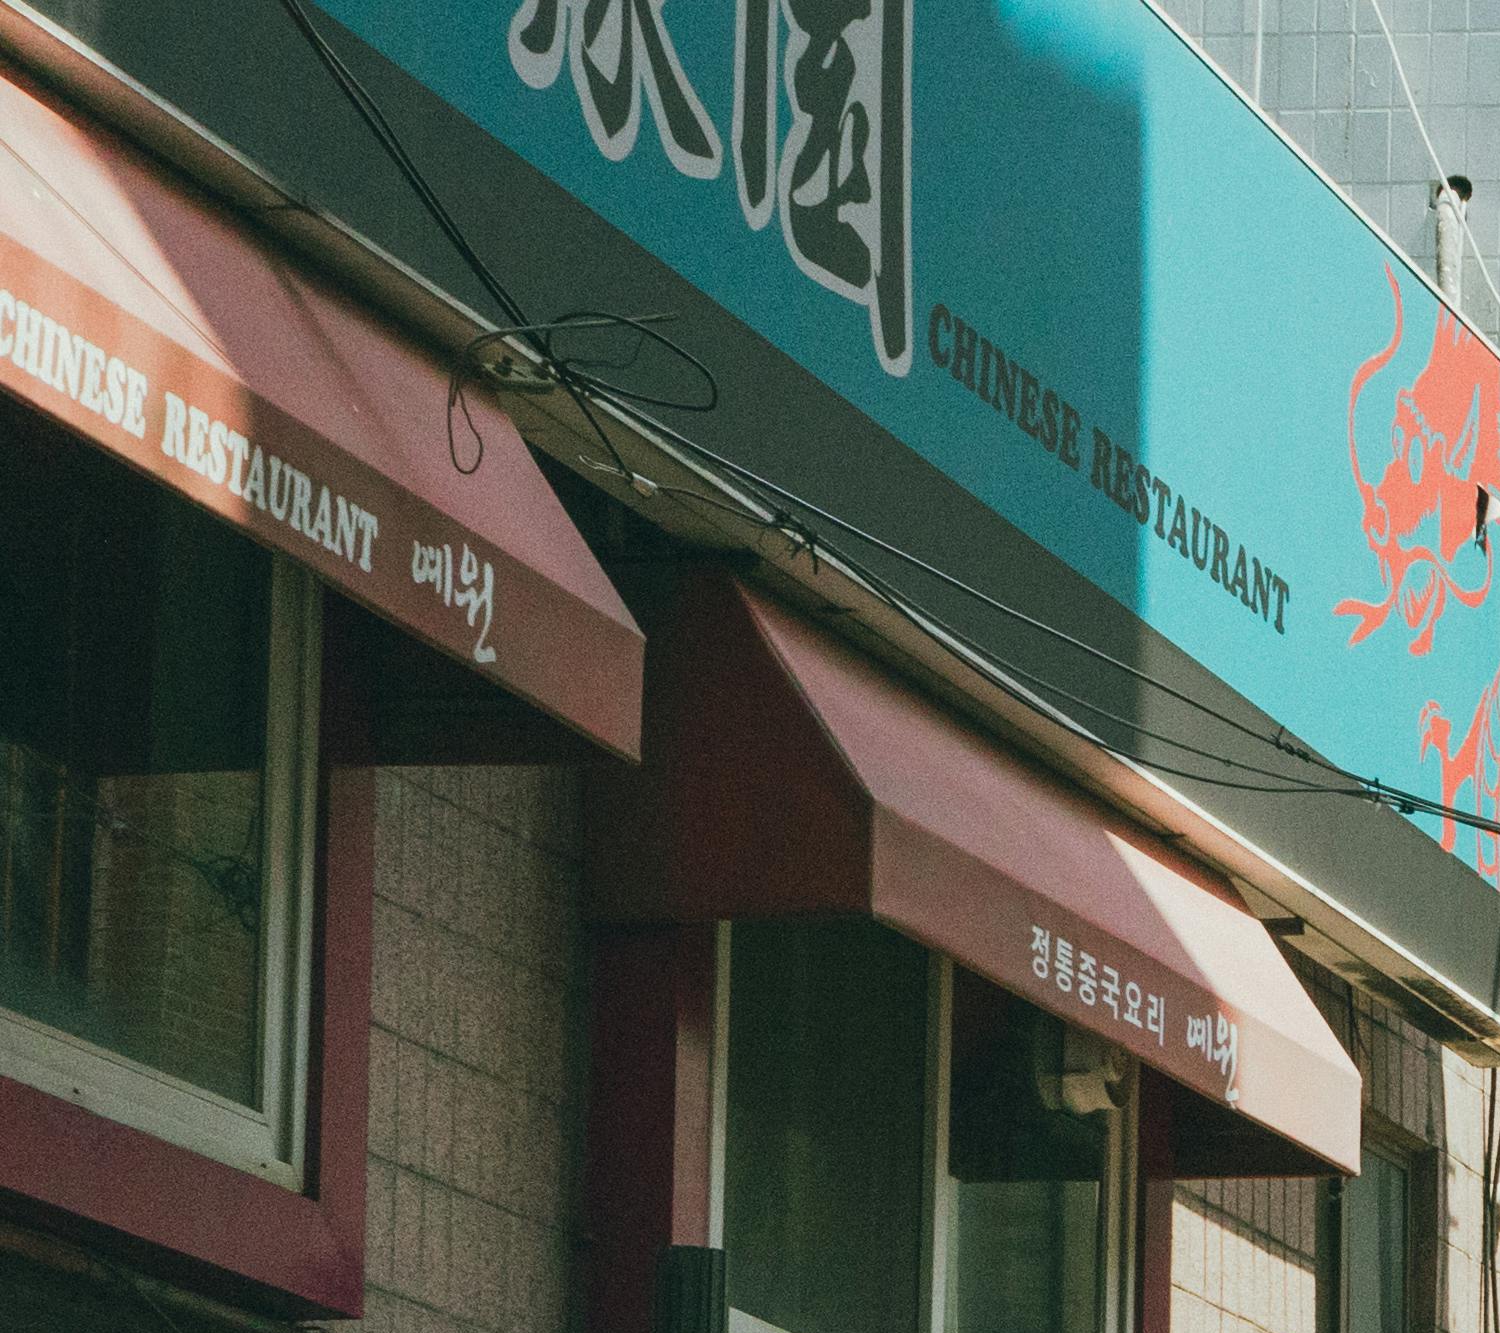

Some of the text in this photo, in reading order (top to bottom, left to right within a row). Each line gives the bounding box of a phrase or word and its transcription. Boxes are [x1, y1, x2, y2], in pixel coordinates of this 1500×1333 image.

[0, 288, 378, 573] CHINESE RESTAURANT
[929, 303, 1290, 635] CHINESE RESTAURANT
[411, 539, 497, 665] 예원
[1032, 925, 1164, 1046] 정통중국요리
